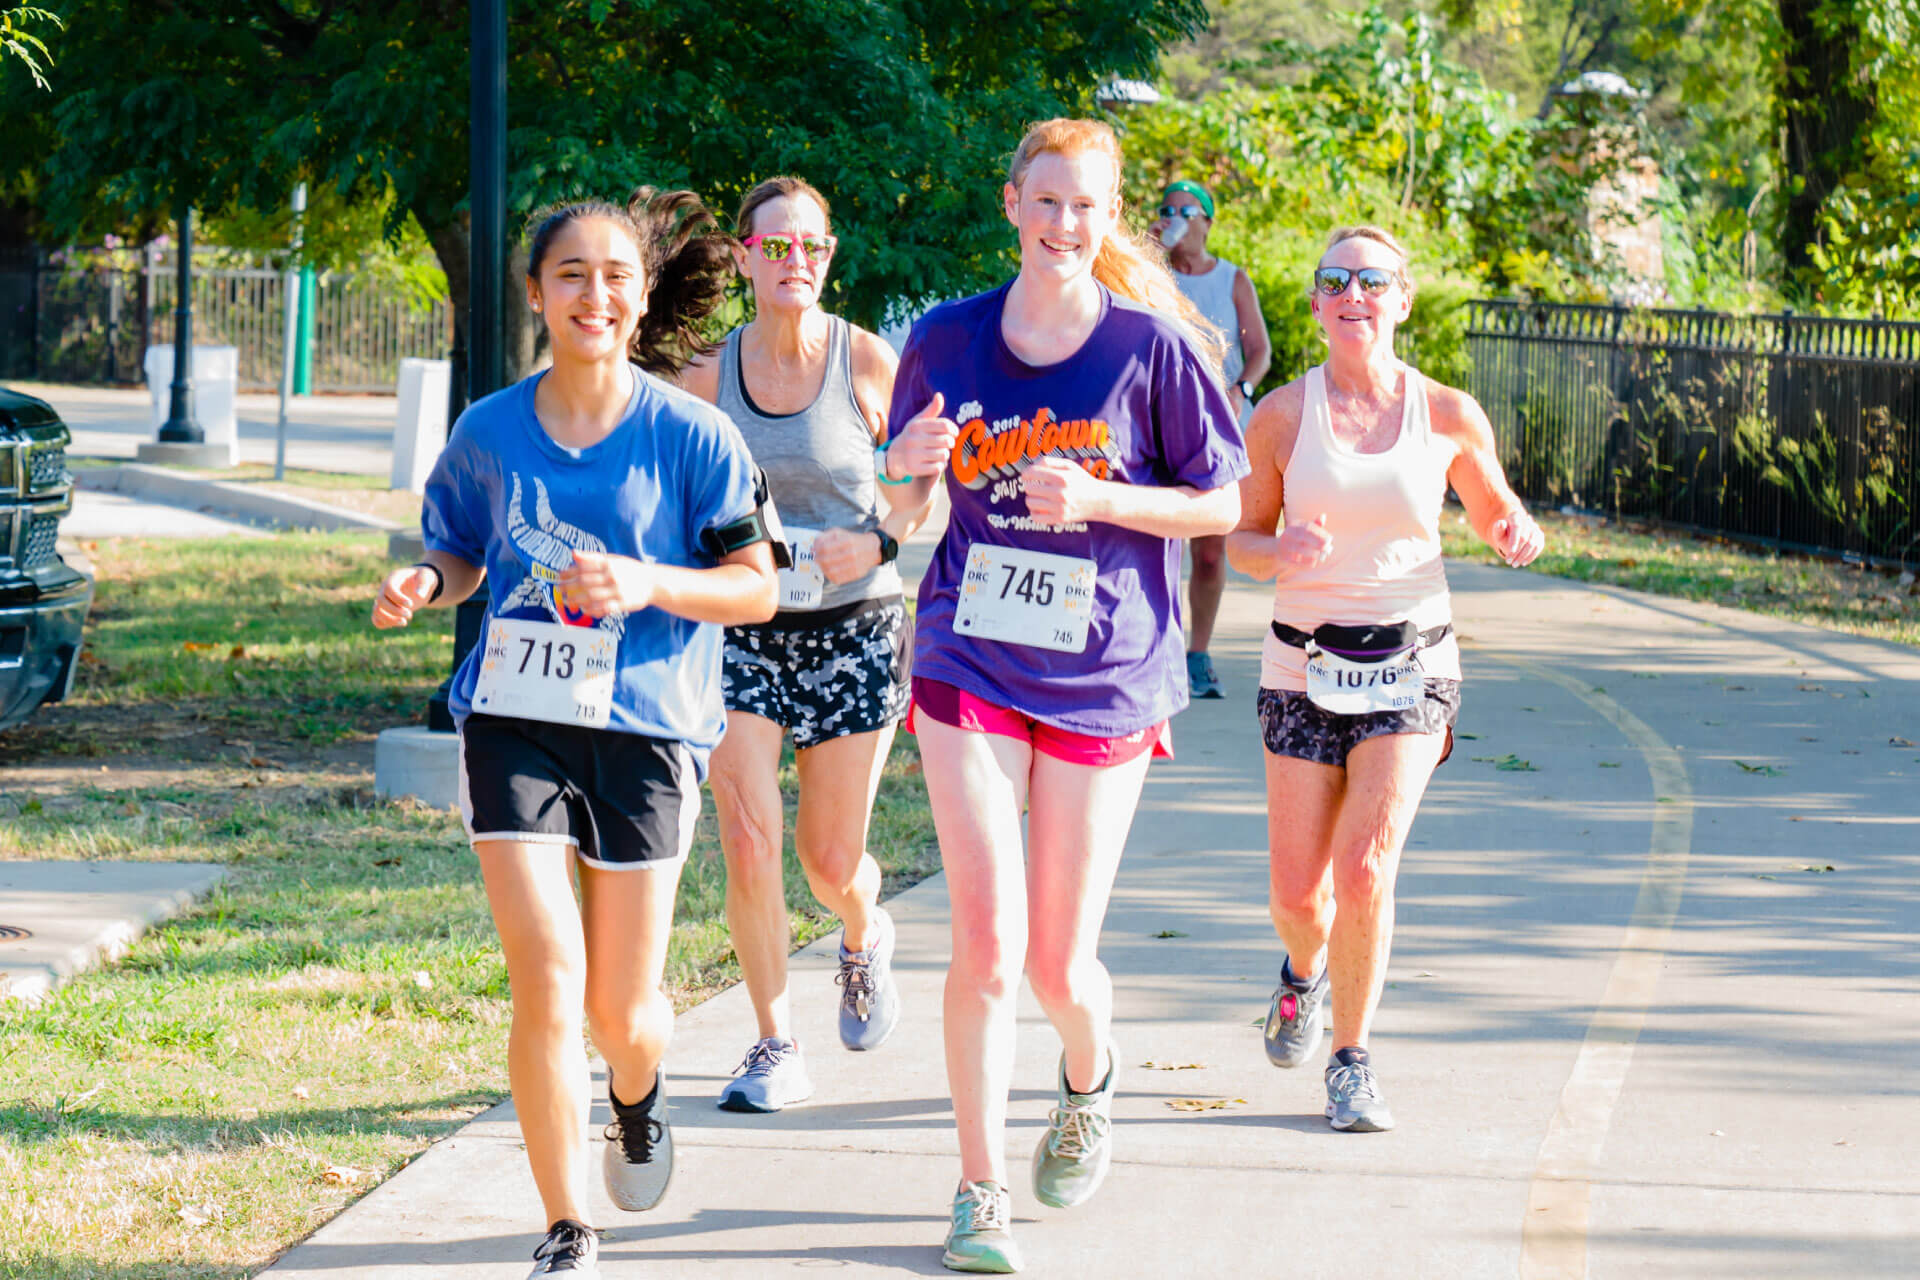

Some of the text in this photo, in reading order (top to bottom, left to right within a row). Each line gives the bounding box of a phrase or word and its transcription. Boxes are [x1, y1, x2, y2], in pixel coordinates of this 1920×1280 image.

[951, 407, 1112, 486] Cowtown
[967, 570, 990, 583] DRC
[999, 564, 1056, 606] 745
[1065, 585, 1090, 598] DRC
[790, 590, 811, 603] 1021
[1053, 629, 1073, 645] 745
[487, 646, 507, 659] DRC
[518, 637, 576, 680] 713
[586, 658, 611, 671] DRC
[1309, 664, 1329, 678] DRC
[1333, 666, 1397, 689] 1076
[1396, 663, 1418, 676] DRC
[575, 703, 596, 720] 713
[1392, 696, 1415, 707] 1076
